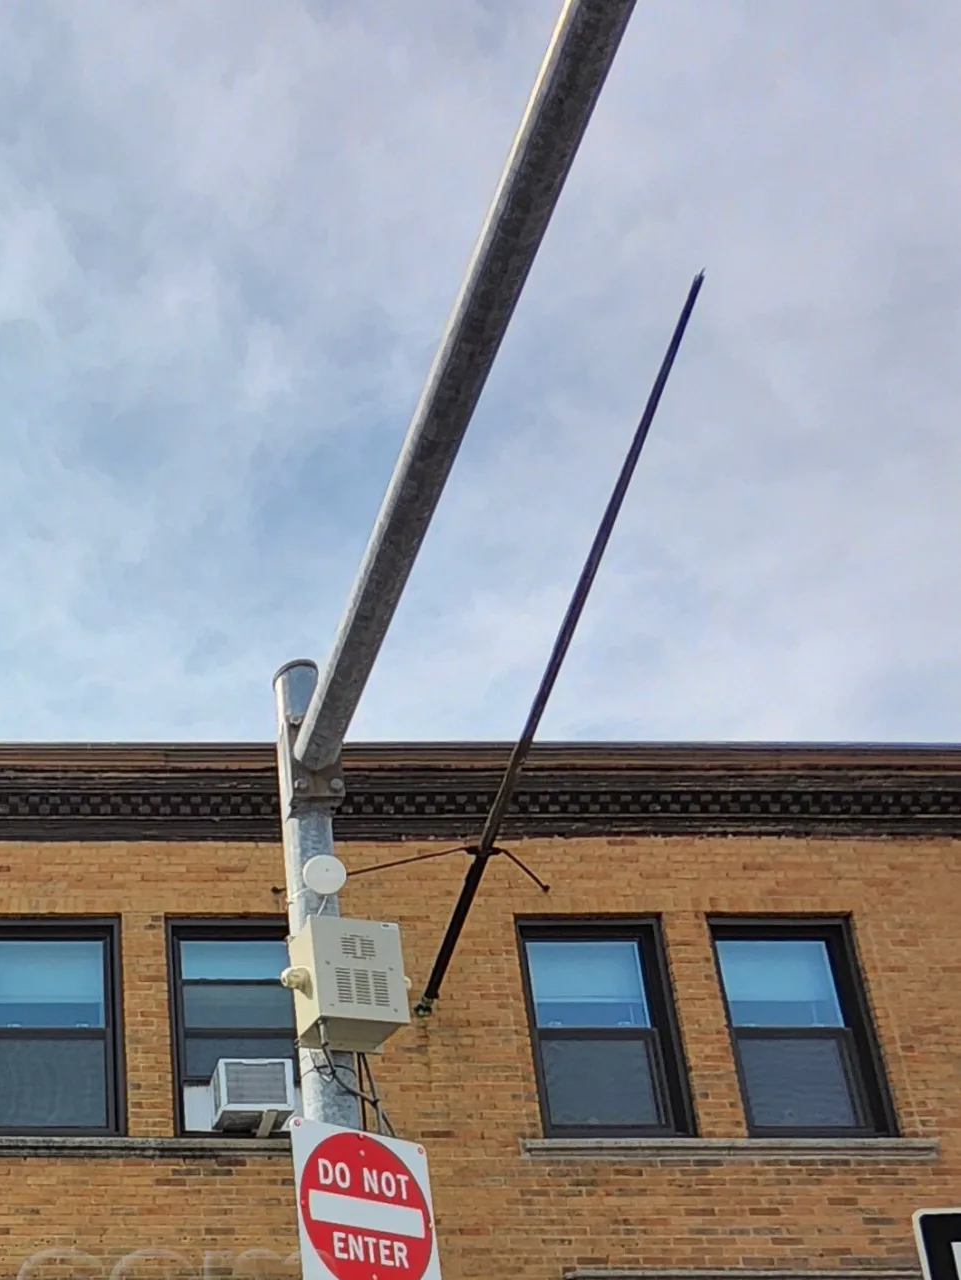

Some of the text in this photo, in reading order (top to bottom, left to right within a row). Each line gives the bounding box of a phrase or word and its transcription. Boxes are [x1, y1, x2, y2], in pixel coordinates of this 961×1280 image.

[318, 1158, 409, 1200] DO NOT
[333, 1232, 409, 1269] ENTER
